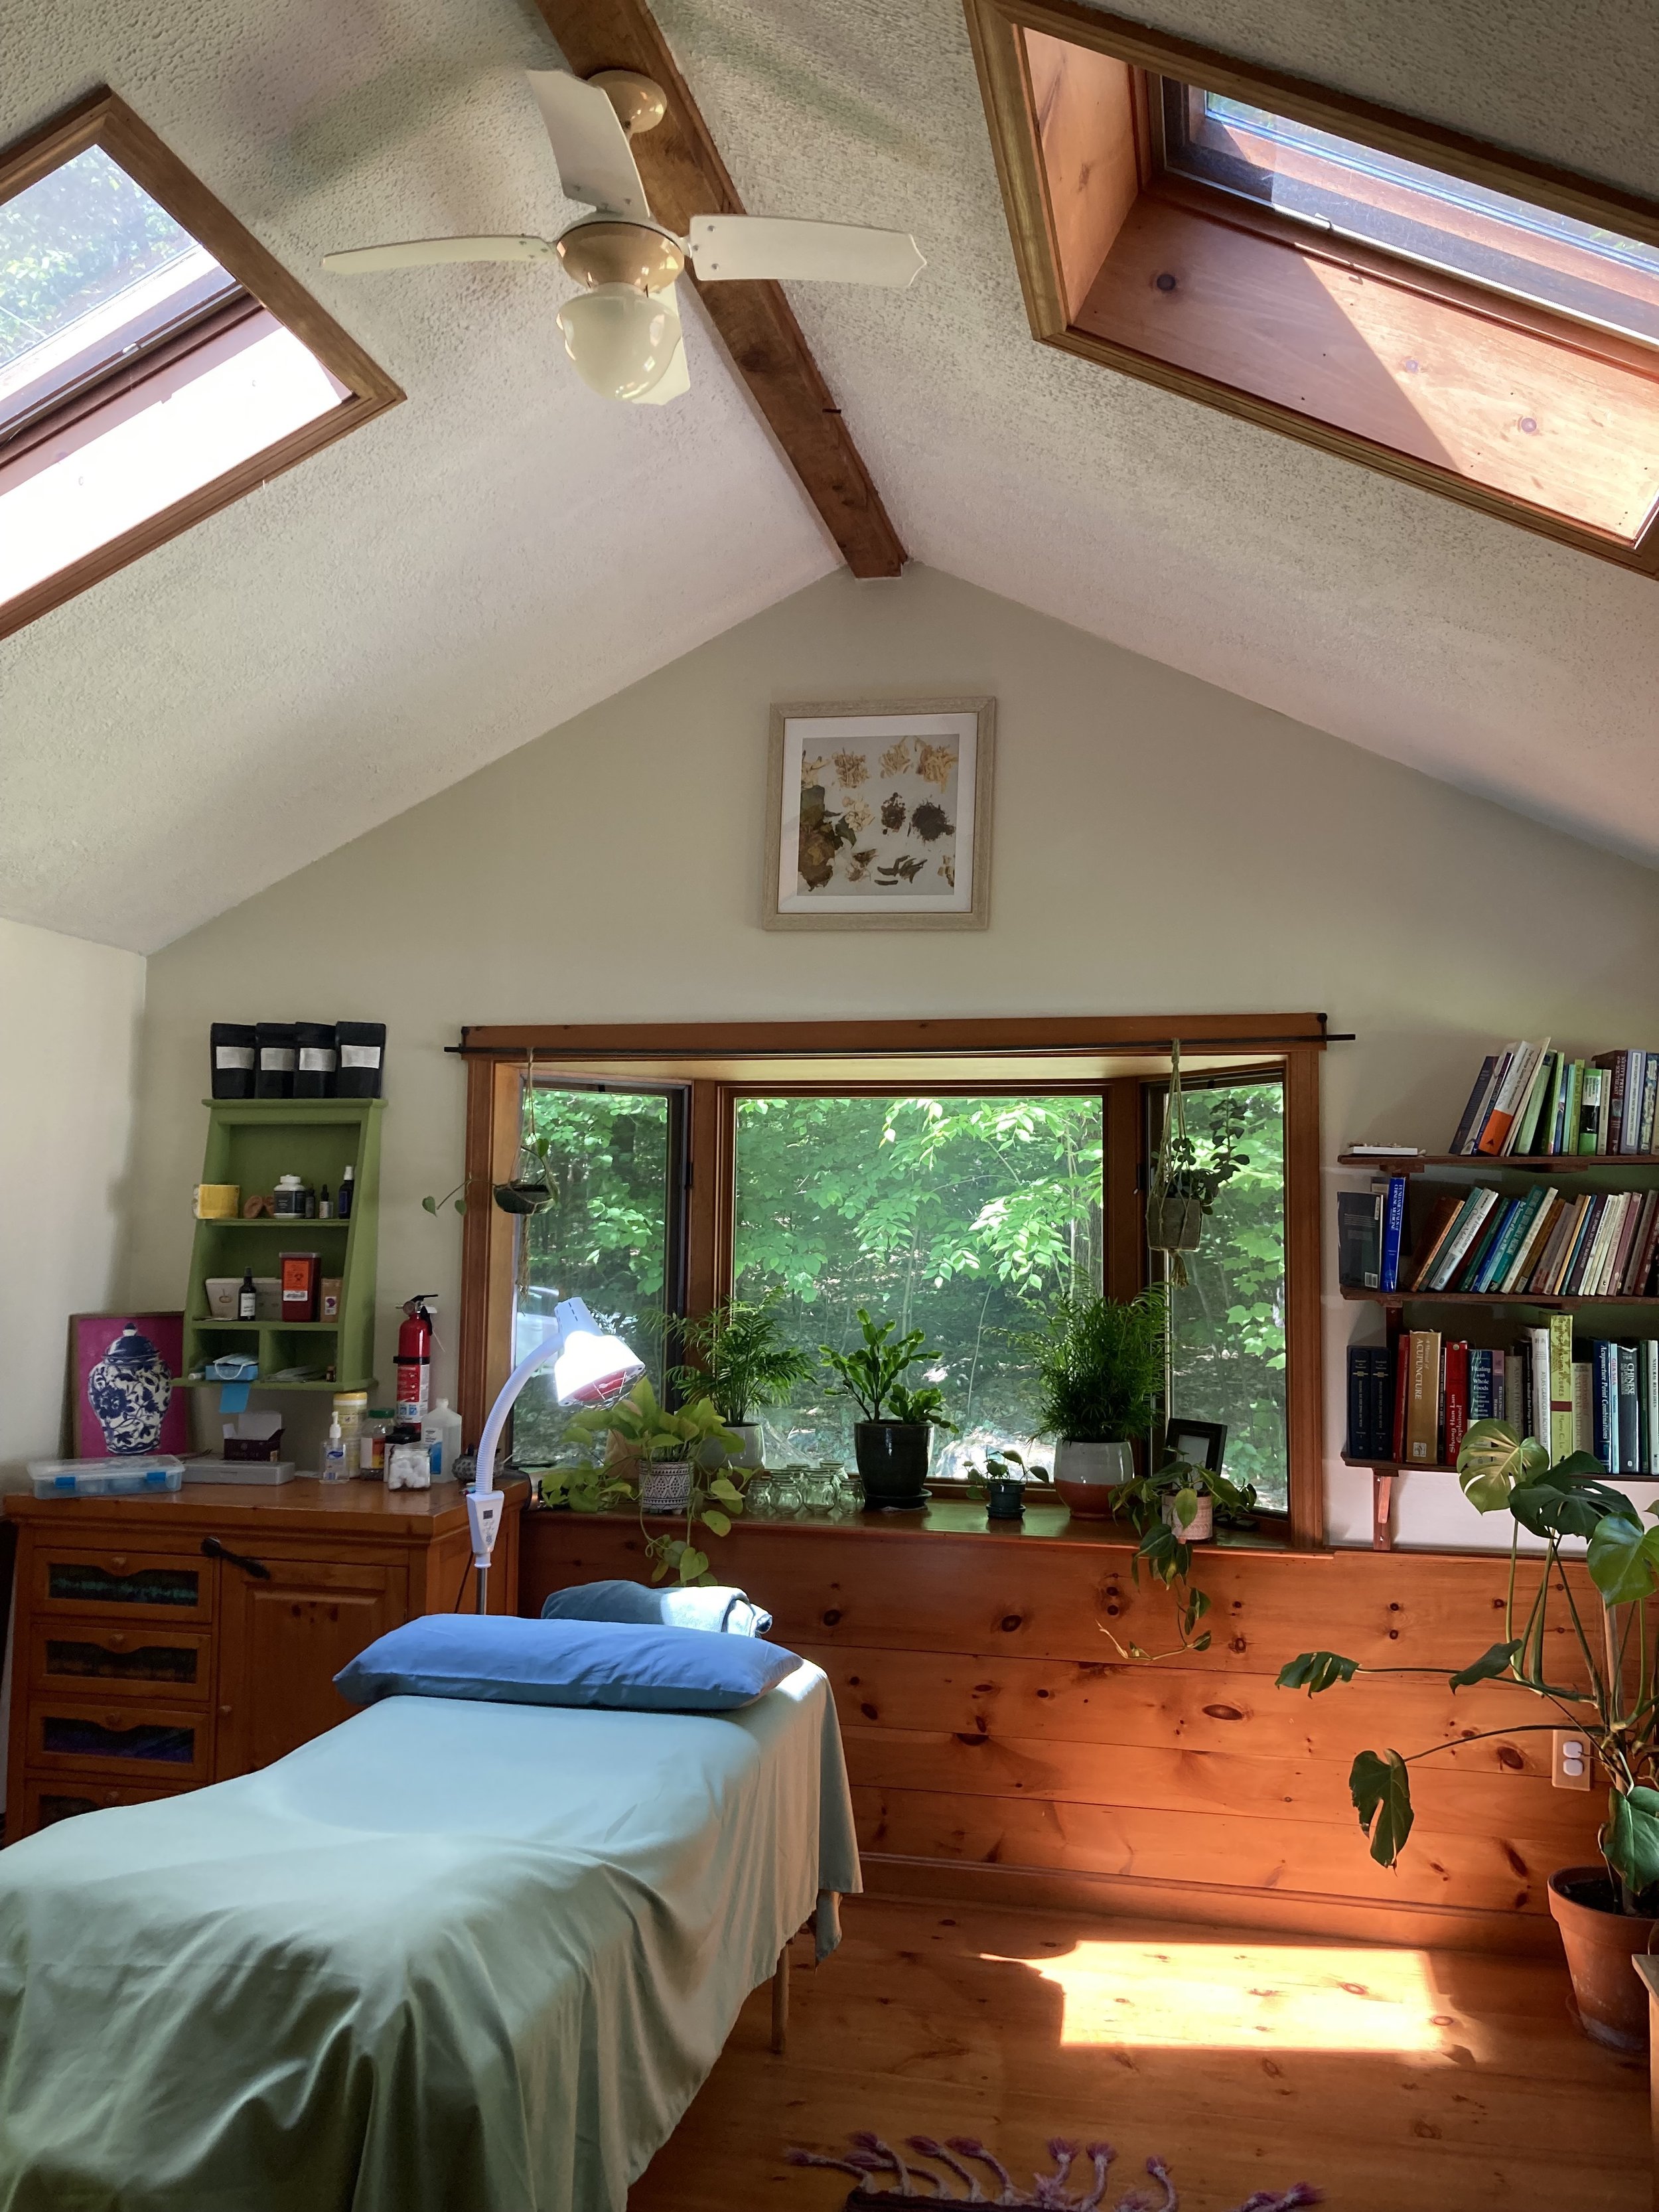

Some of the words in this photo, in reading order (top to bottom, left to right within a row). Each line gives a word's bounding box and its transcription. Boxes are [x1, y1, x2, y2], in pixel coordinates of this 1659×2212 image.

[1394, 1185, 1403, 1224] FUNDAMENTALS
[1464, 1207, 1479, 1226] Chinese
[1476, 1212, 1485, 1222] The
[1453, 1226, 1469, 1248] Medicine
[1460, 1220, 1480, 1249] Foundations
[1414, 1338, 1424, 1399] ACUPUNCTURE
[1599, 1345, 1607, 1380] Acupuncture
